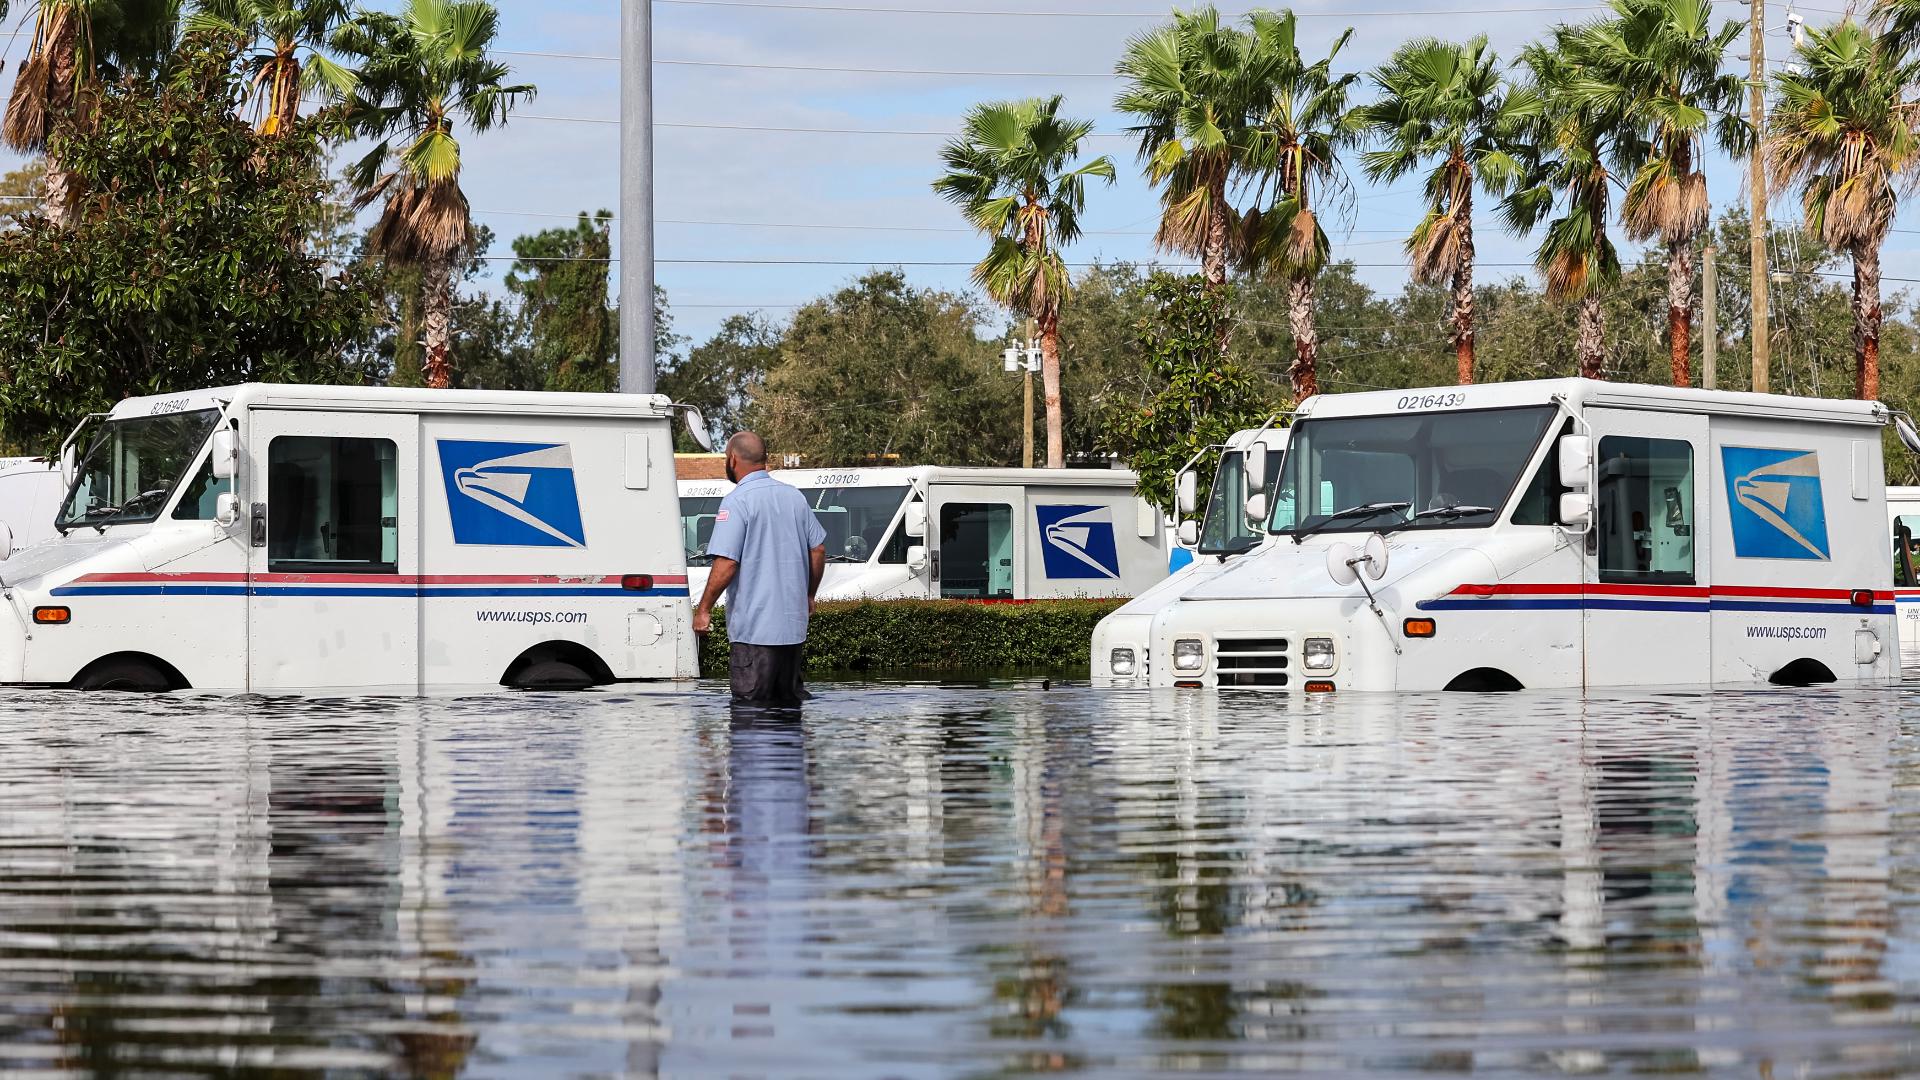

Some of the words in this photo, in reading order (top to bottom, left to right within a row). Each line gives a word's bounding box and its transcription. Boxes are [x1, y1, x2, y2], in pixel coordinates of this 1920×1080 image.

[151, 398, 190, 415] 8216940
[1397, 392, 1466, 410] 0216439
[815, 474, 860, 485] 3309109
[476, 610, 588, 626] www.usps.com
[1746, 626, 1827, 642] www.usps.com
